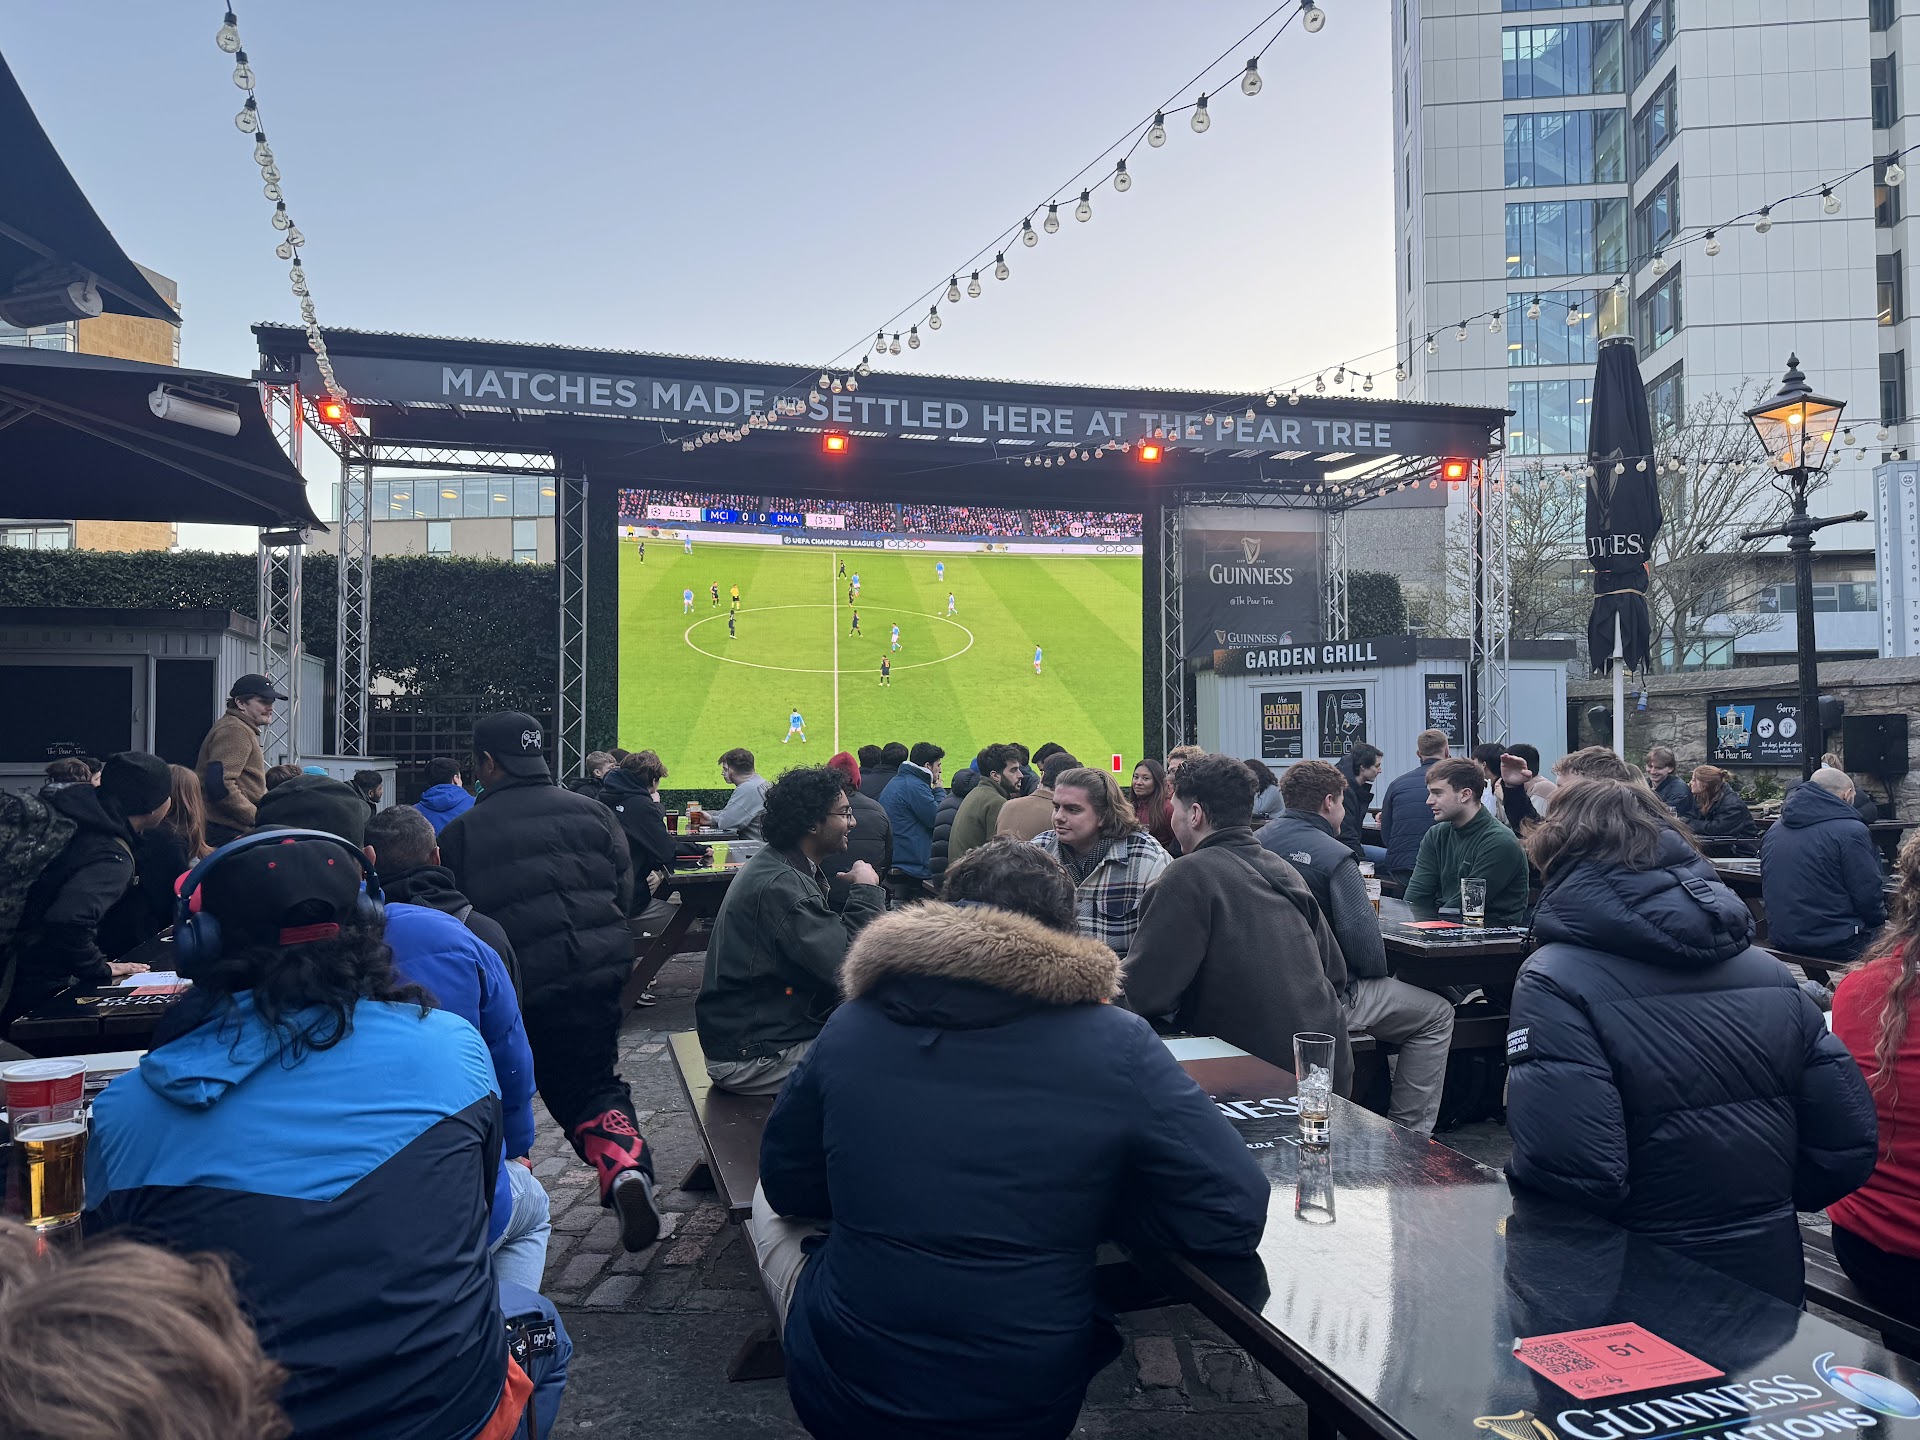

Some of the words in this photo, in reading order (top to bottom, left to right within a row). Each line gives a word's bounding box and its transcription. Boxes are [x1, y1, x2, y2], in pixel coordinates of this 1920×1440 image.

[441, 366, 638, 408] MATCHES
[652, 383, 765, 415] MADE
[808, 392, 969, 430] SETTLED
[982, 404, 1074, 435] HERE
[1086, 411, 1127, 437] AT
[1139, 412, 1203, 440] THE
[1215, 416, 1301, 444] PEAR
[1311, 421, 1392, 448] TREE
[710, 511, 729, 520] MCI
[742, 512, 749, 521] 0
[759, 513, 766, 522] 0
[776, 515, 799, 524] RMA
[811, 538, 850, 546] CHAMPIONS
[850, 539, 875, 547] LEAGUE
[1209, 563, 1293, 585] GUINNESS
[1261, 596, 1274, 606] Tree
[1227, 632, 1278, 643] GUINNESS
[1245, 647, 1316, 669] GARDEN
[1322, 642, 1378, 664] GRILL
[1277, 695, 1287, 703] the
[1264, 703, 1300, 715] GARDEN
[1264, 715, 1301, 731] GRILL
[1713, 749, 1724, 760] The
[1724, 749, 1739, 760] Pear
[1740, 749, 1753, 760] Tree
[1508, 1035, 1527, 1048] LONDON
[1508, 1043, 1529, 1056] ENGLAND
[1571, 1335, 1601, 1343] TABLE
[1599, 1330, 1636, 1340] NUMBER
[1606, 1342, 1645, 1357] 51
[1556, 1374, 1823, 1440] GUINNESS
